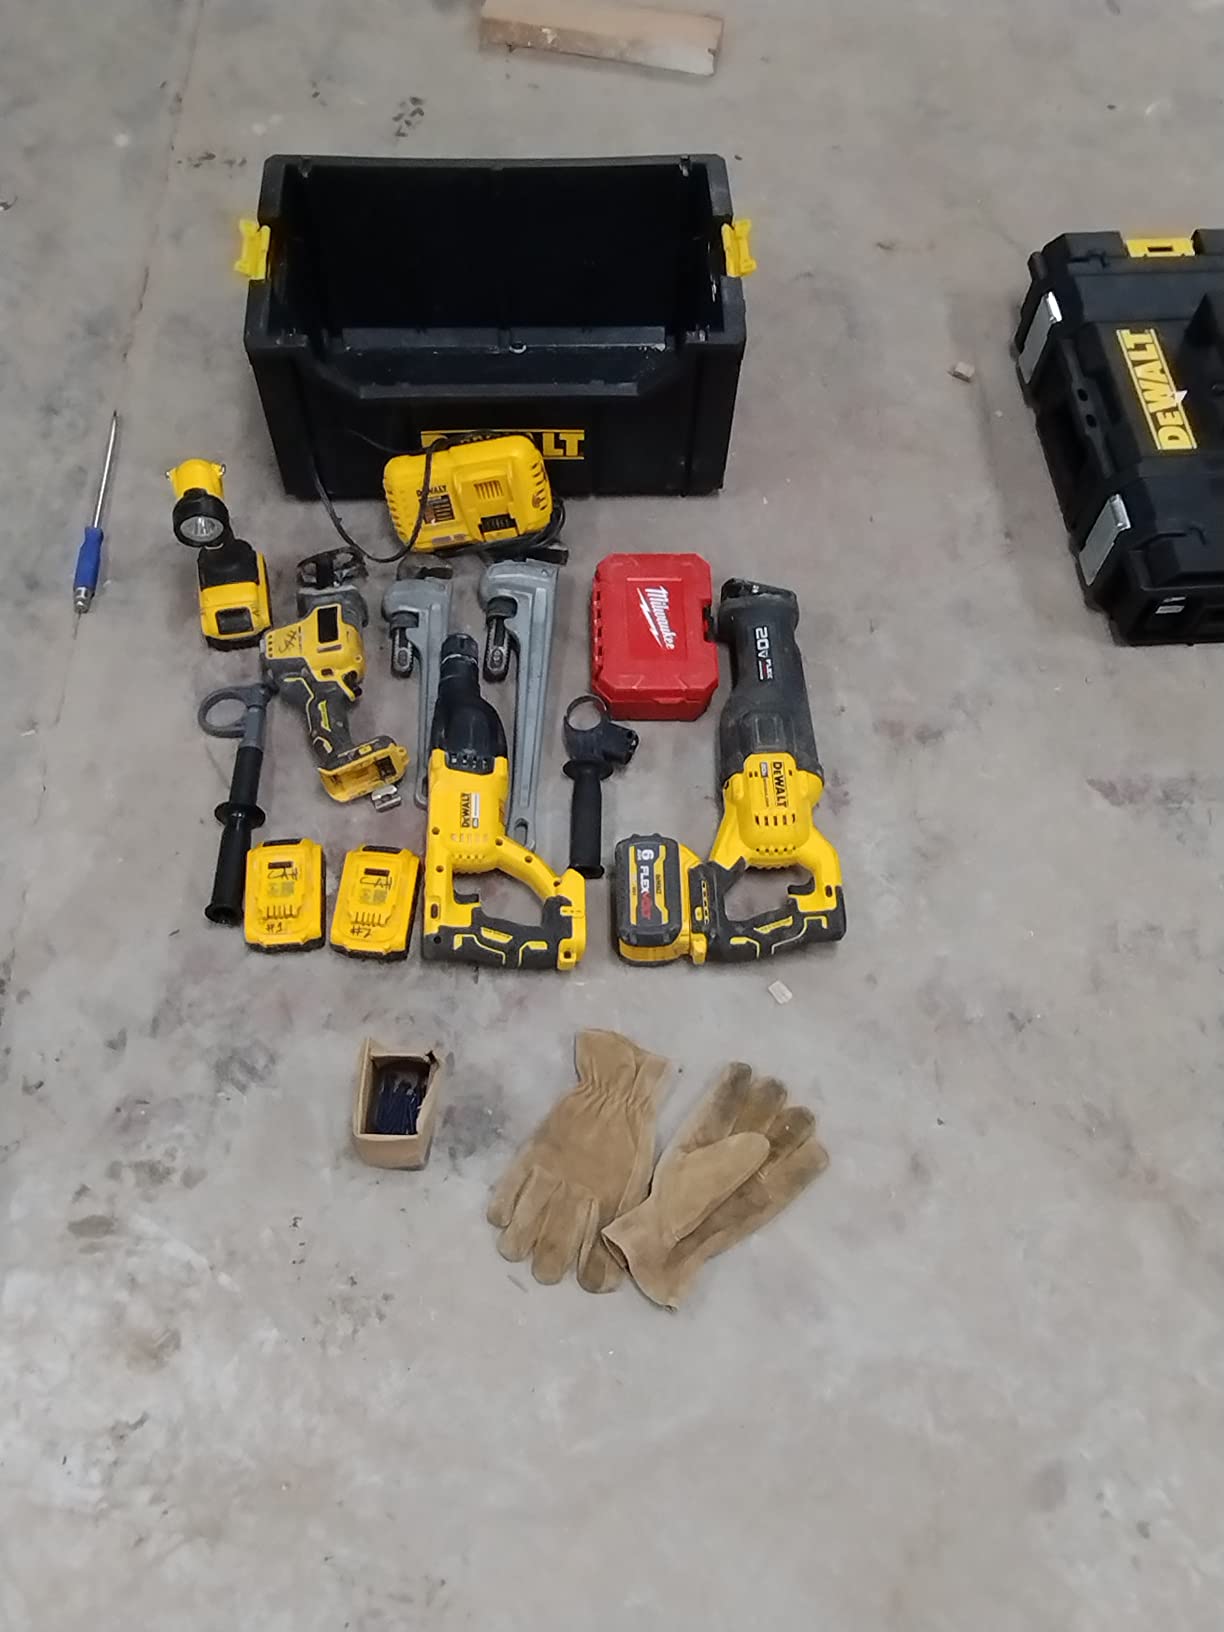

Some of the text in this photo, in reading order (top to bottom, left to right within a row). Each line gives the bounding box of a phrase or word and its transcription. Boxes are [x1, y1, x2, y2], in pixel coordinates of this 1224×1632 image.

[1118, 329, 1194, 449] DEWALT
[416, 484, 447, 497] DALT
[645, 585, 677, 650] Milwaukee
[641, 849, 654, 861] 6
